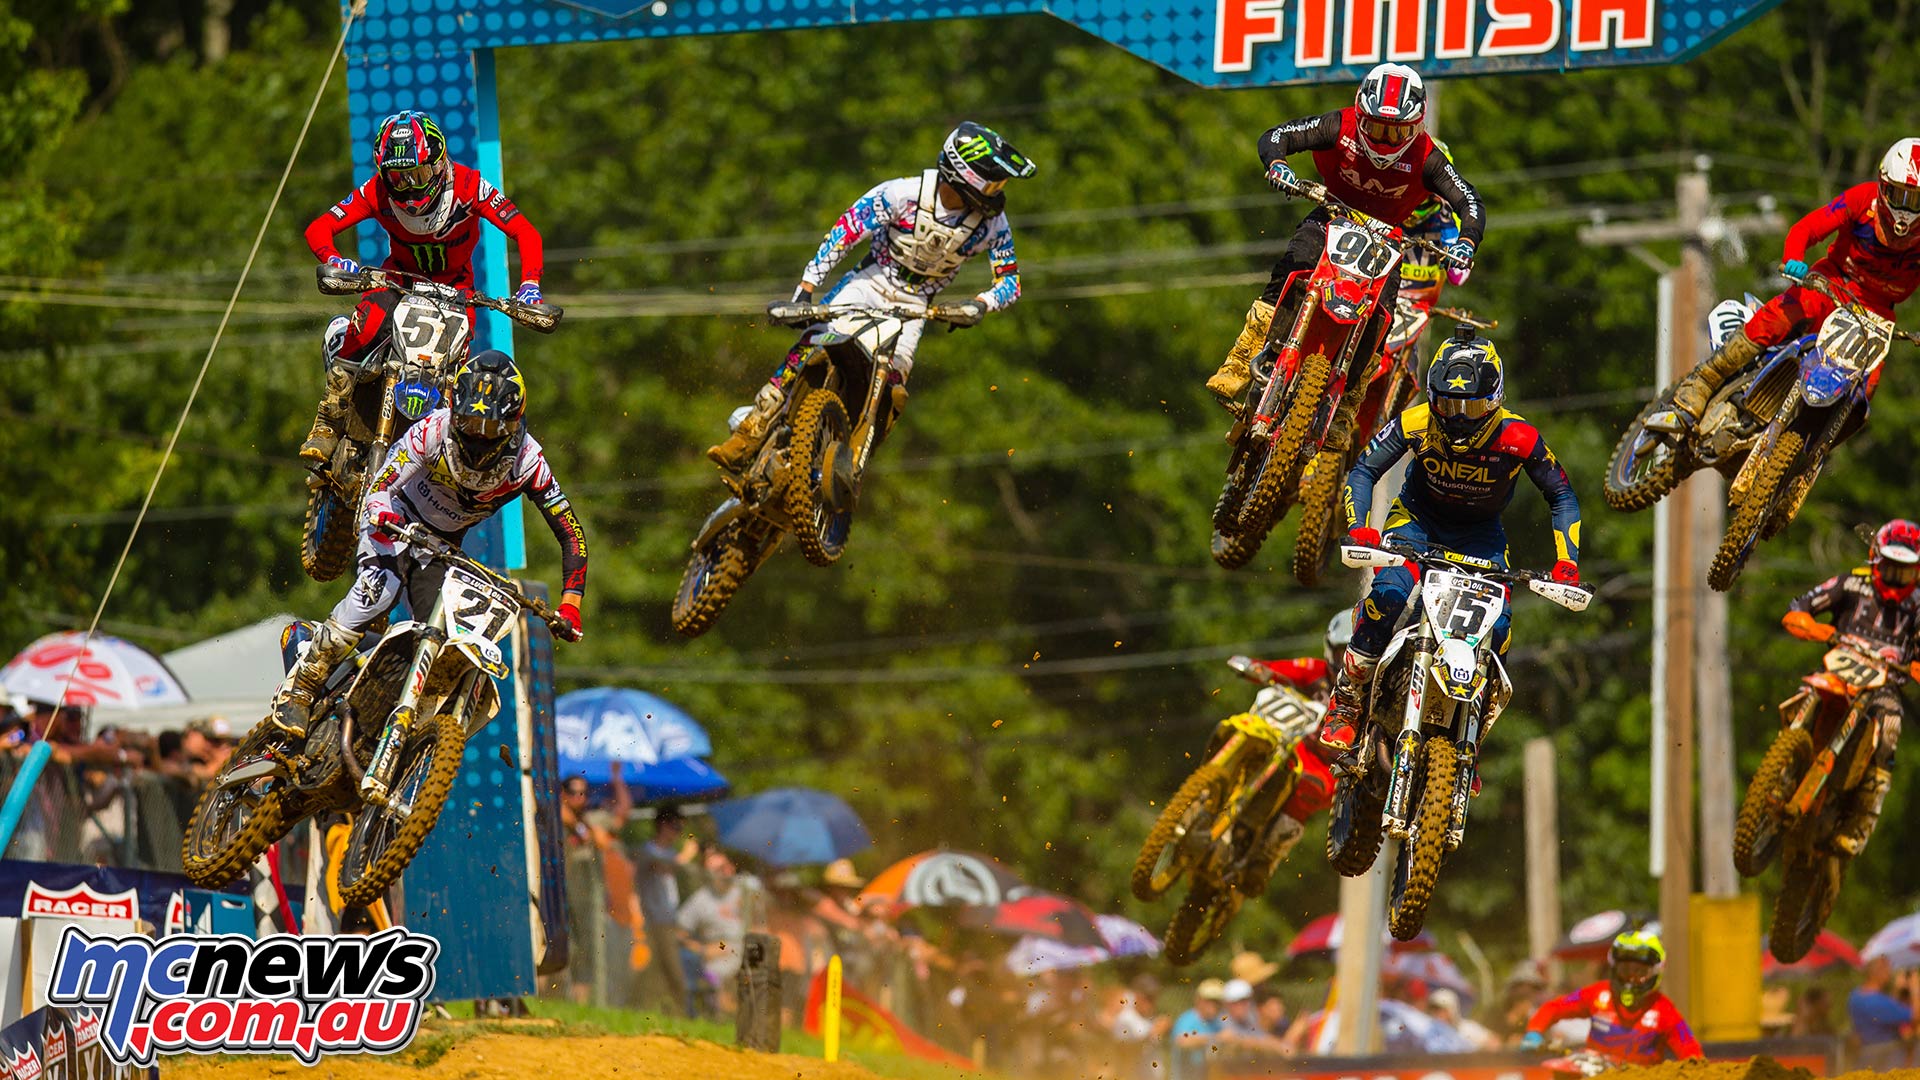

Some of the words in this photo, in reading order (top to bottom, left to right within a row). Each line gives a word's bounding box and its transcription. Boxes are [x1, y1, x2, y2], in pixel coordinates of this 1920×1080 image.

[439, 302, 450, 310] OIL
[402, 306, 465, 355] 51
[1820, 317, 1887, 370] 700
[1438, 480, 1491, 492] Husqvarna
[491, 591, 503, 601] OIL
[1472, 583, 1483, 591] OIL
[453, 588, 511, 641] 21
[1436, 588, 1492, 635] 15
[1456, 767, 1468, 825] DUNLOP
[33, 898, 127, 918] RACER
